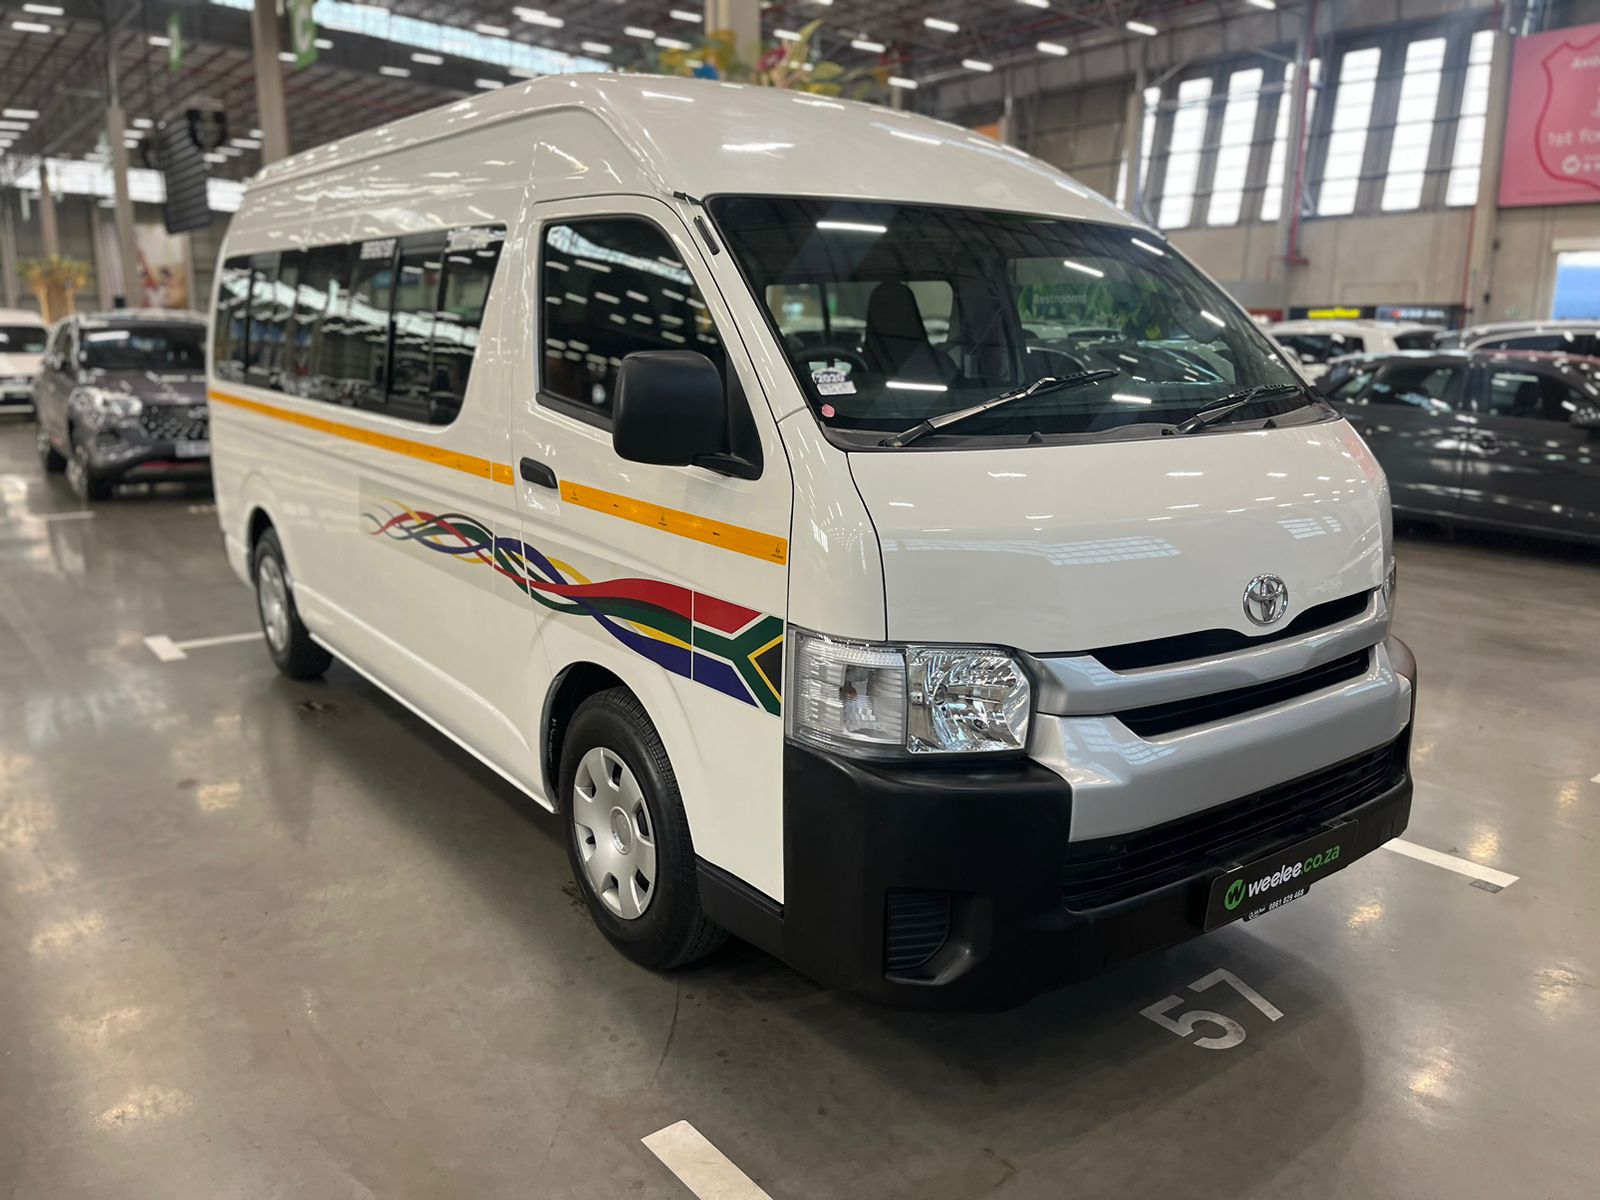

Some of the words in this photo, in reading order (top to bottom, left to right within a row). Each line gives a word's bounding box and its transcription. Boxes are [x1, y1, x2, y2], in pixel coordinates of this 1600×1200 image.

[1248, 845, 1340, 898] weelee.co.za
[1282, 893, 1294, 904] 829
[1139, 968, 1284, 1050] 57
